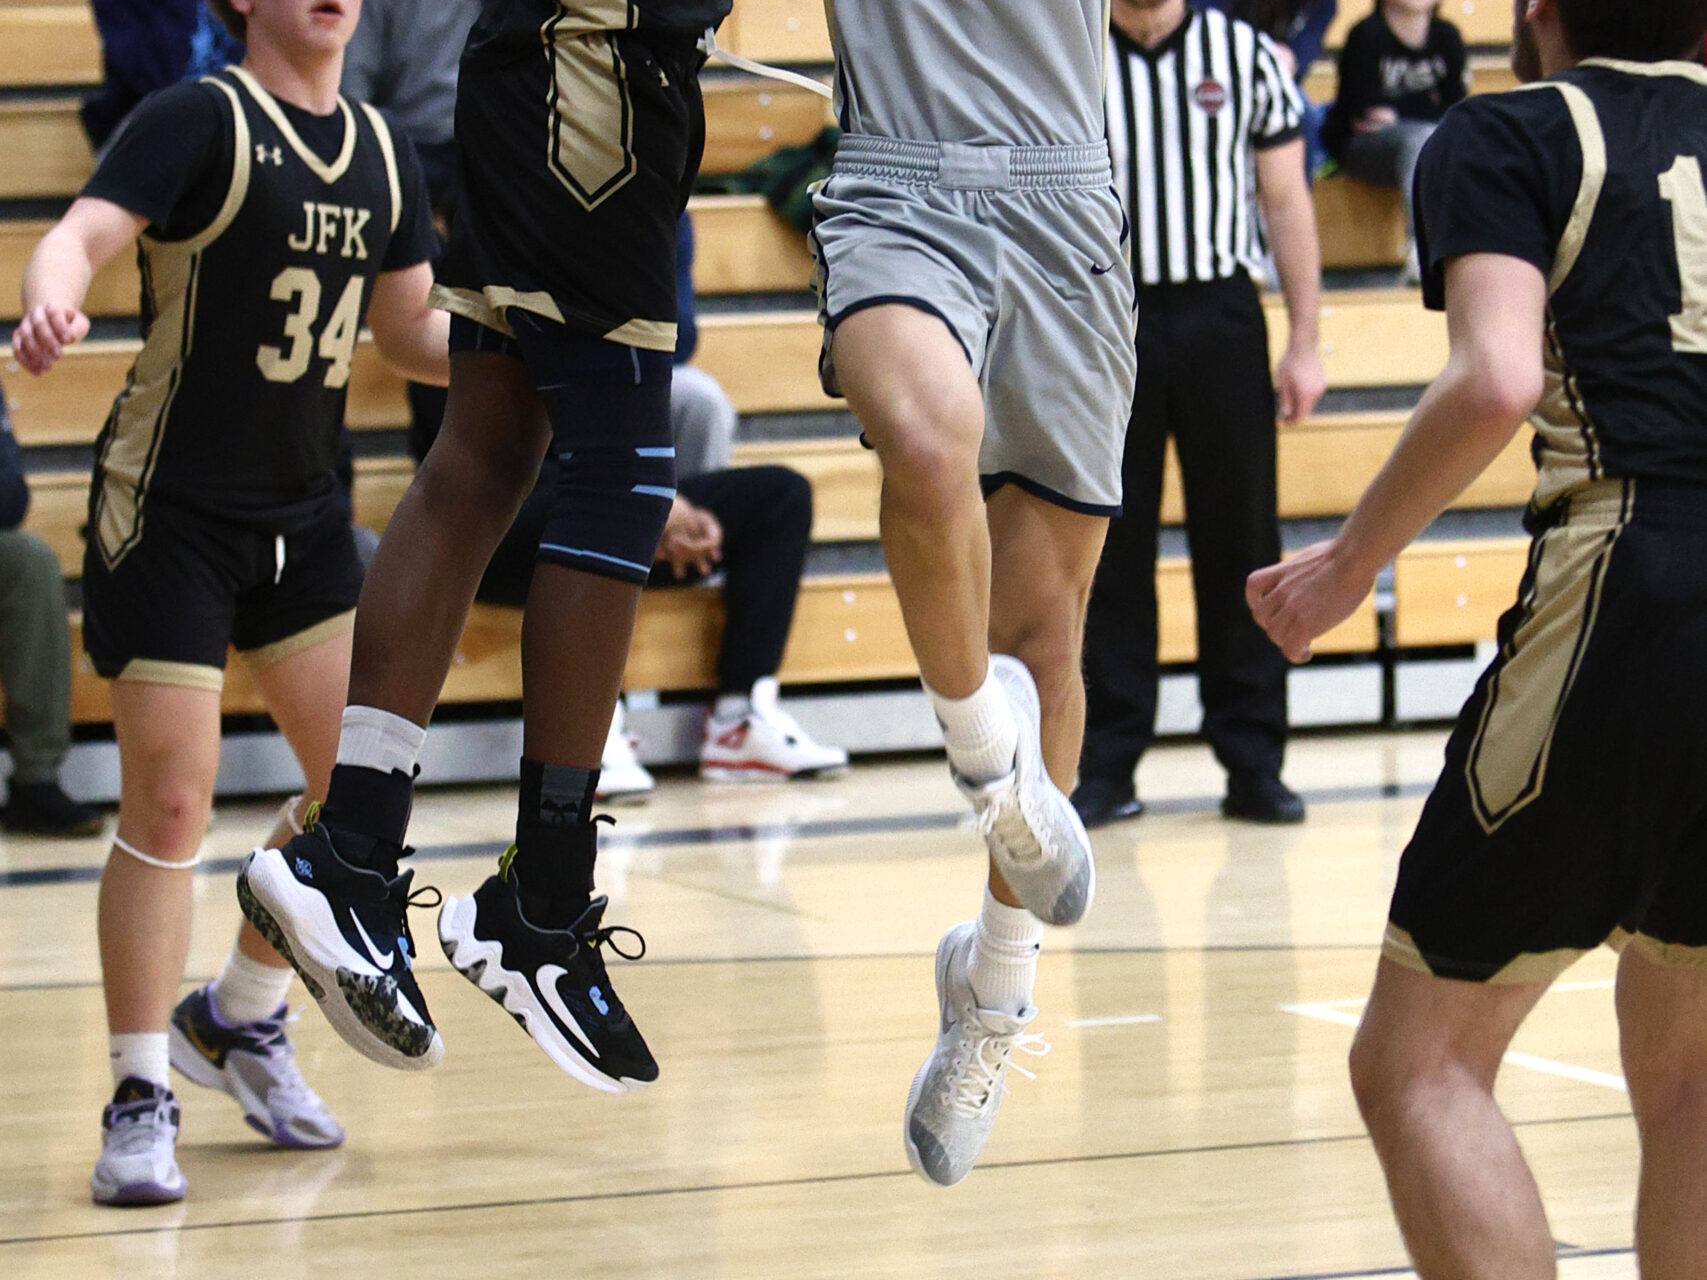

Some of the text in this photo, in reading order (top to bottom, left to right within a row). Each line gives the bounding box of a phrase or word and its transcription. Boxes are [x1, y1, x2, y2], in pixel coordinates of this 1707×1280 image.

[287, 201, 371, 260] JFK
[1657, 154, 1707, 354] 1
[255, 266, 366, 390] 34
